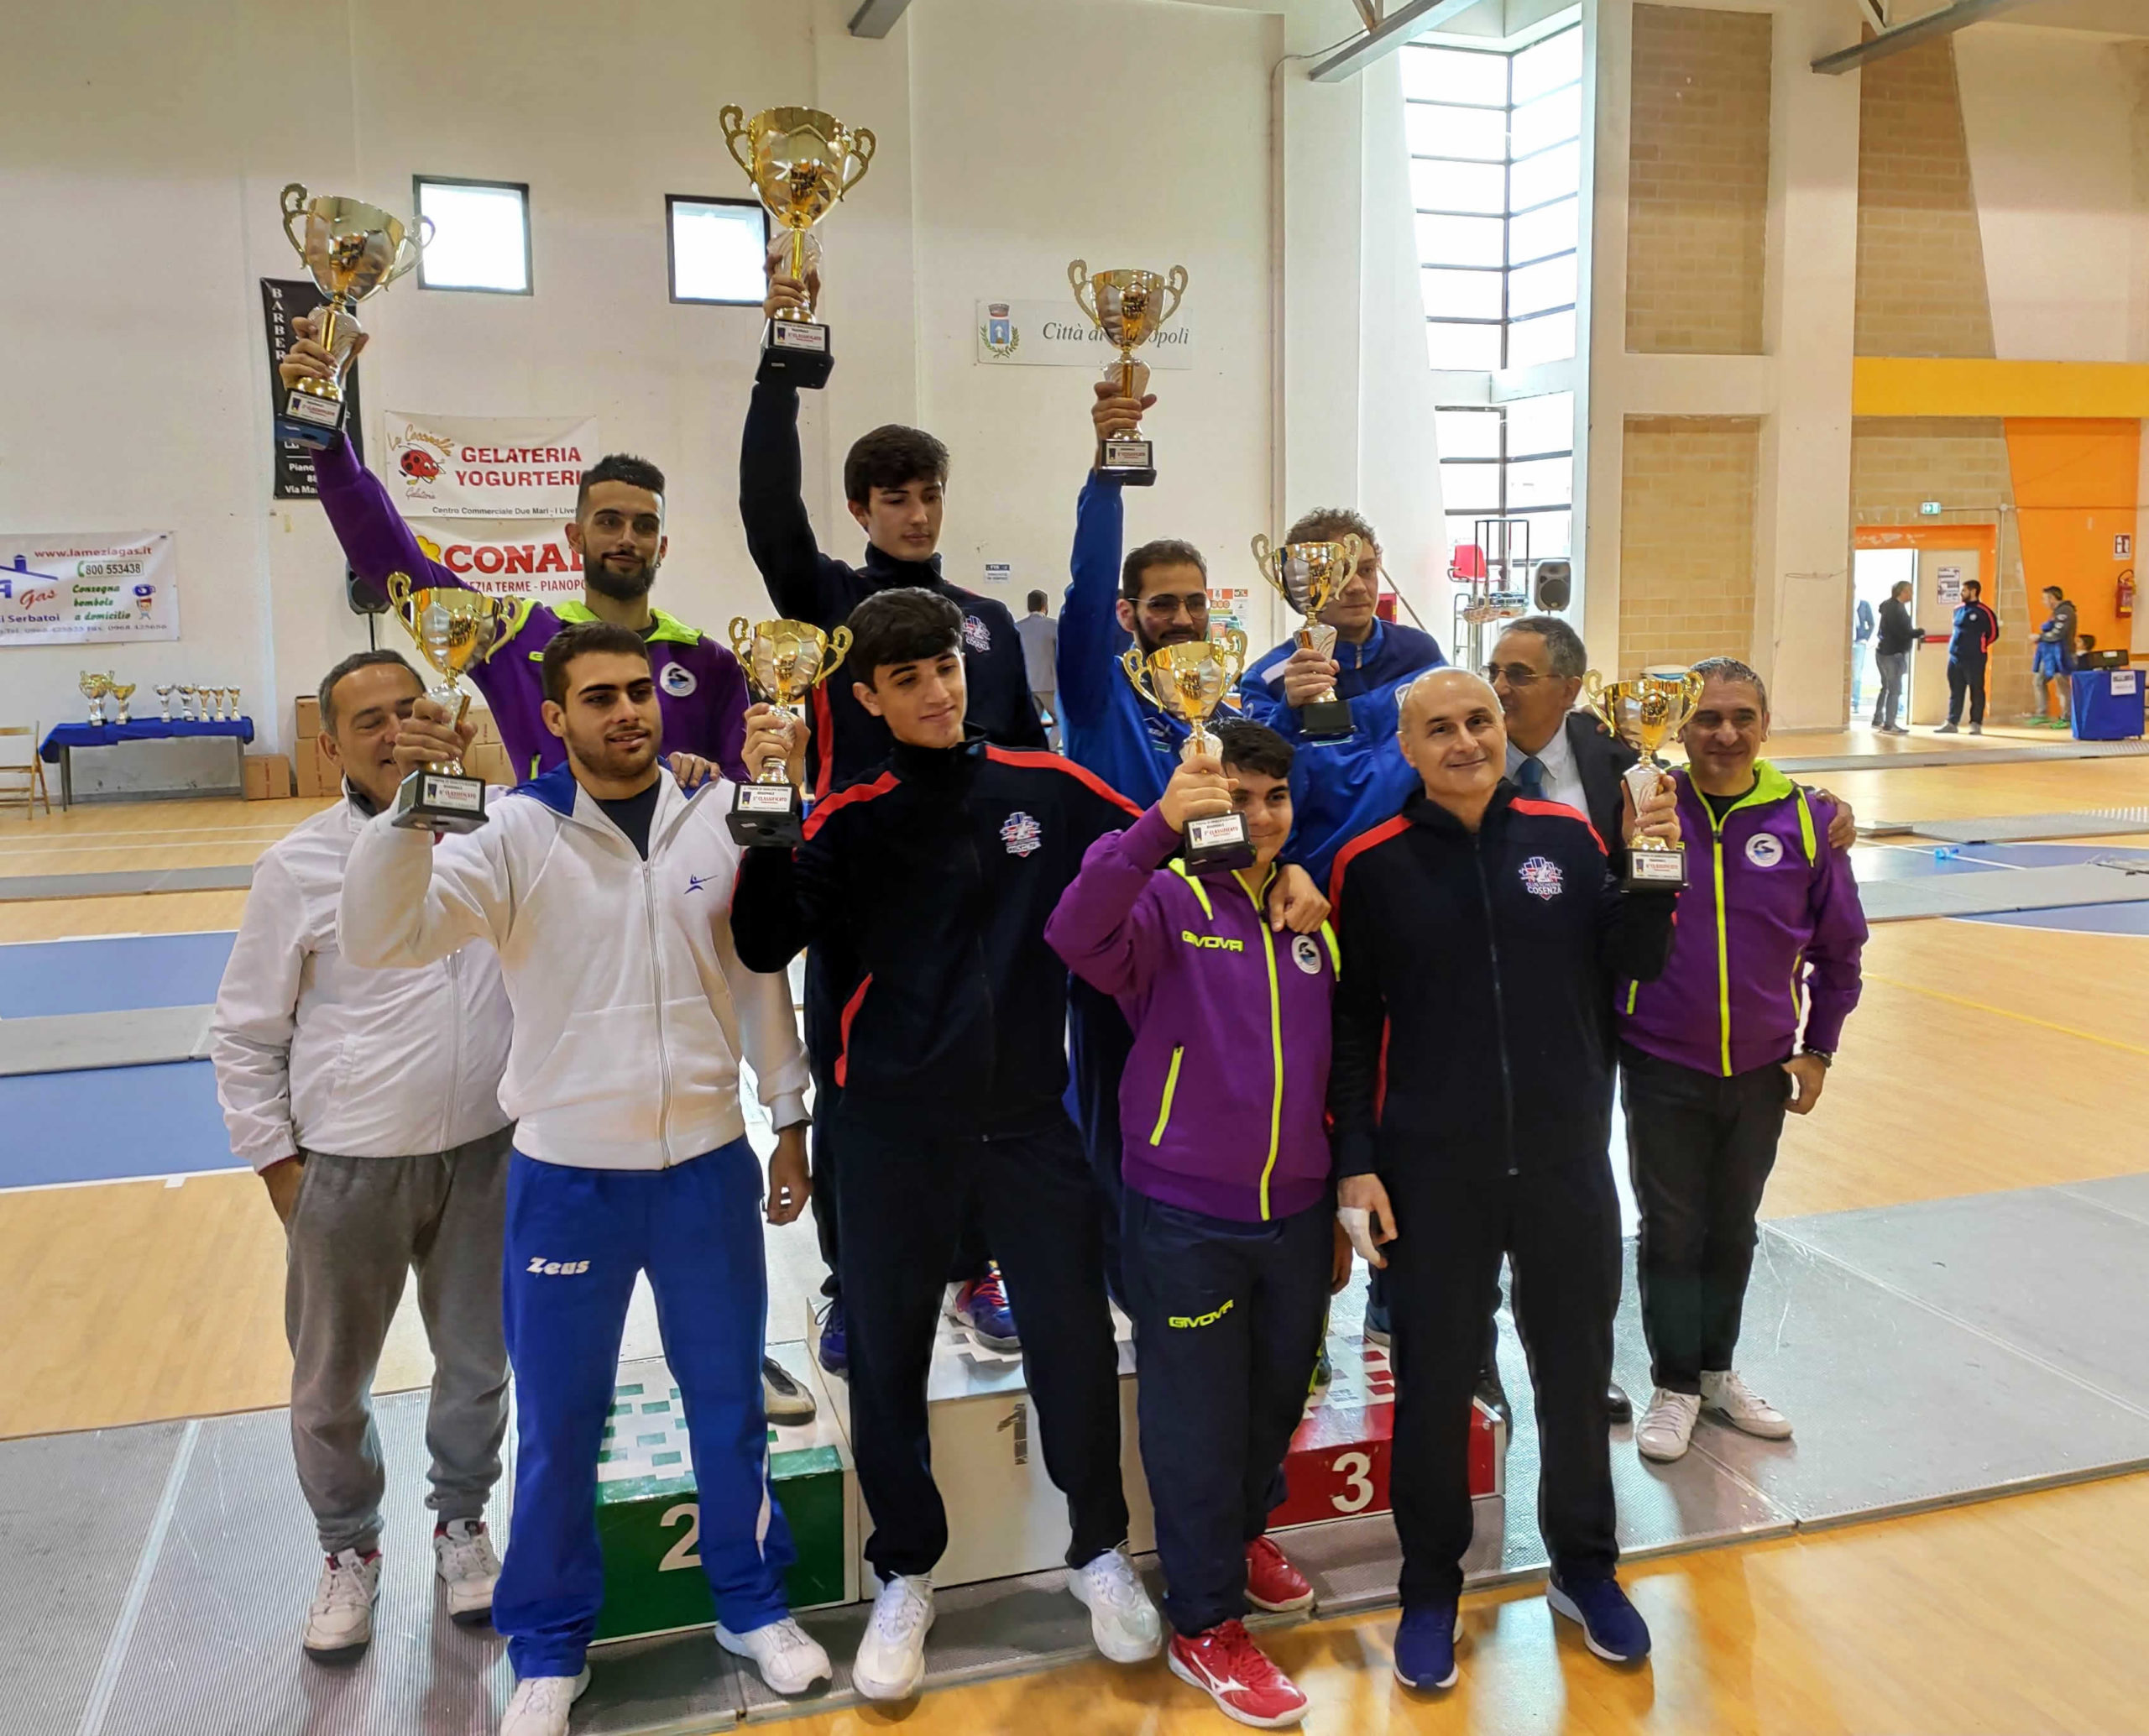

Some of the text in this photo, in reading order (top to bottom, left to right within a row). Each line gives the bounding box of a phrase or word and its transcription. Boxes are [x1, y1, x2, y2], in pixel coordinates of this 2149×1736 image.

[271, 288, 286, 361] BARBER
[1043, 322, 1083, 341] Città
[461, 447, 582, 463] GELATERIA
[285, 484, 300, 494] Via
[432, 505, 459, 514] Centro
[532, 506, 549, 515] Mari
[34, 546, 152, 557] www.lameziagas.it
[86, 563, 141, 575] 800 553438
[72, 584, 120, 594] Consegna
[495, 581, 531, 593] TERME
[19, 589, 57, 610] Gas
[8, 613, 60, 623] Serbatoi
[84, 611, 131, 621] domicilio
[1527, 886, 1563, 896] COSENZA
[525, 1257, 591, 1275] Zeus
[1169, 1299, 1234, 1328] GIVOVA
[1331, 1451, 1375, 1514] 3
[657, 1502, 703, 1572] 2
